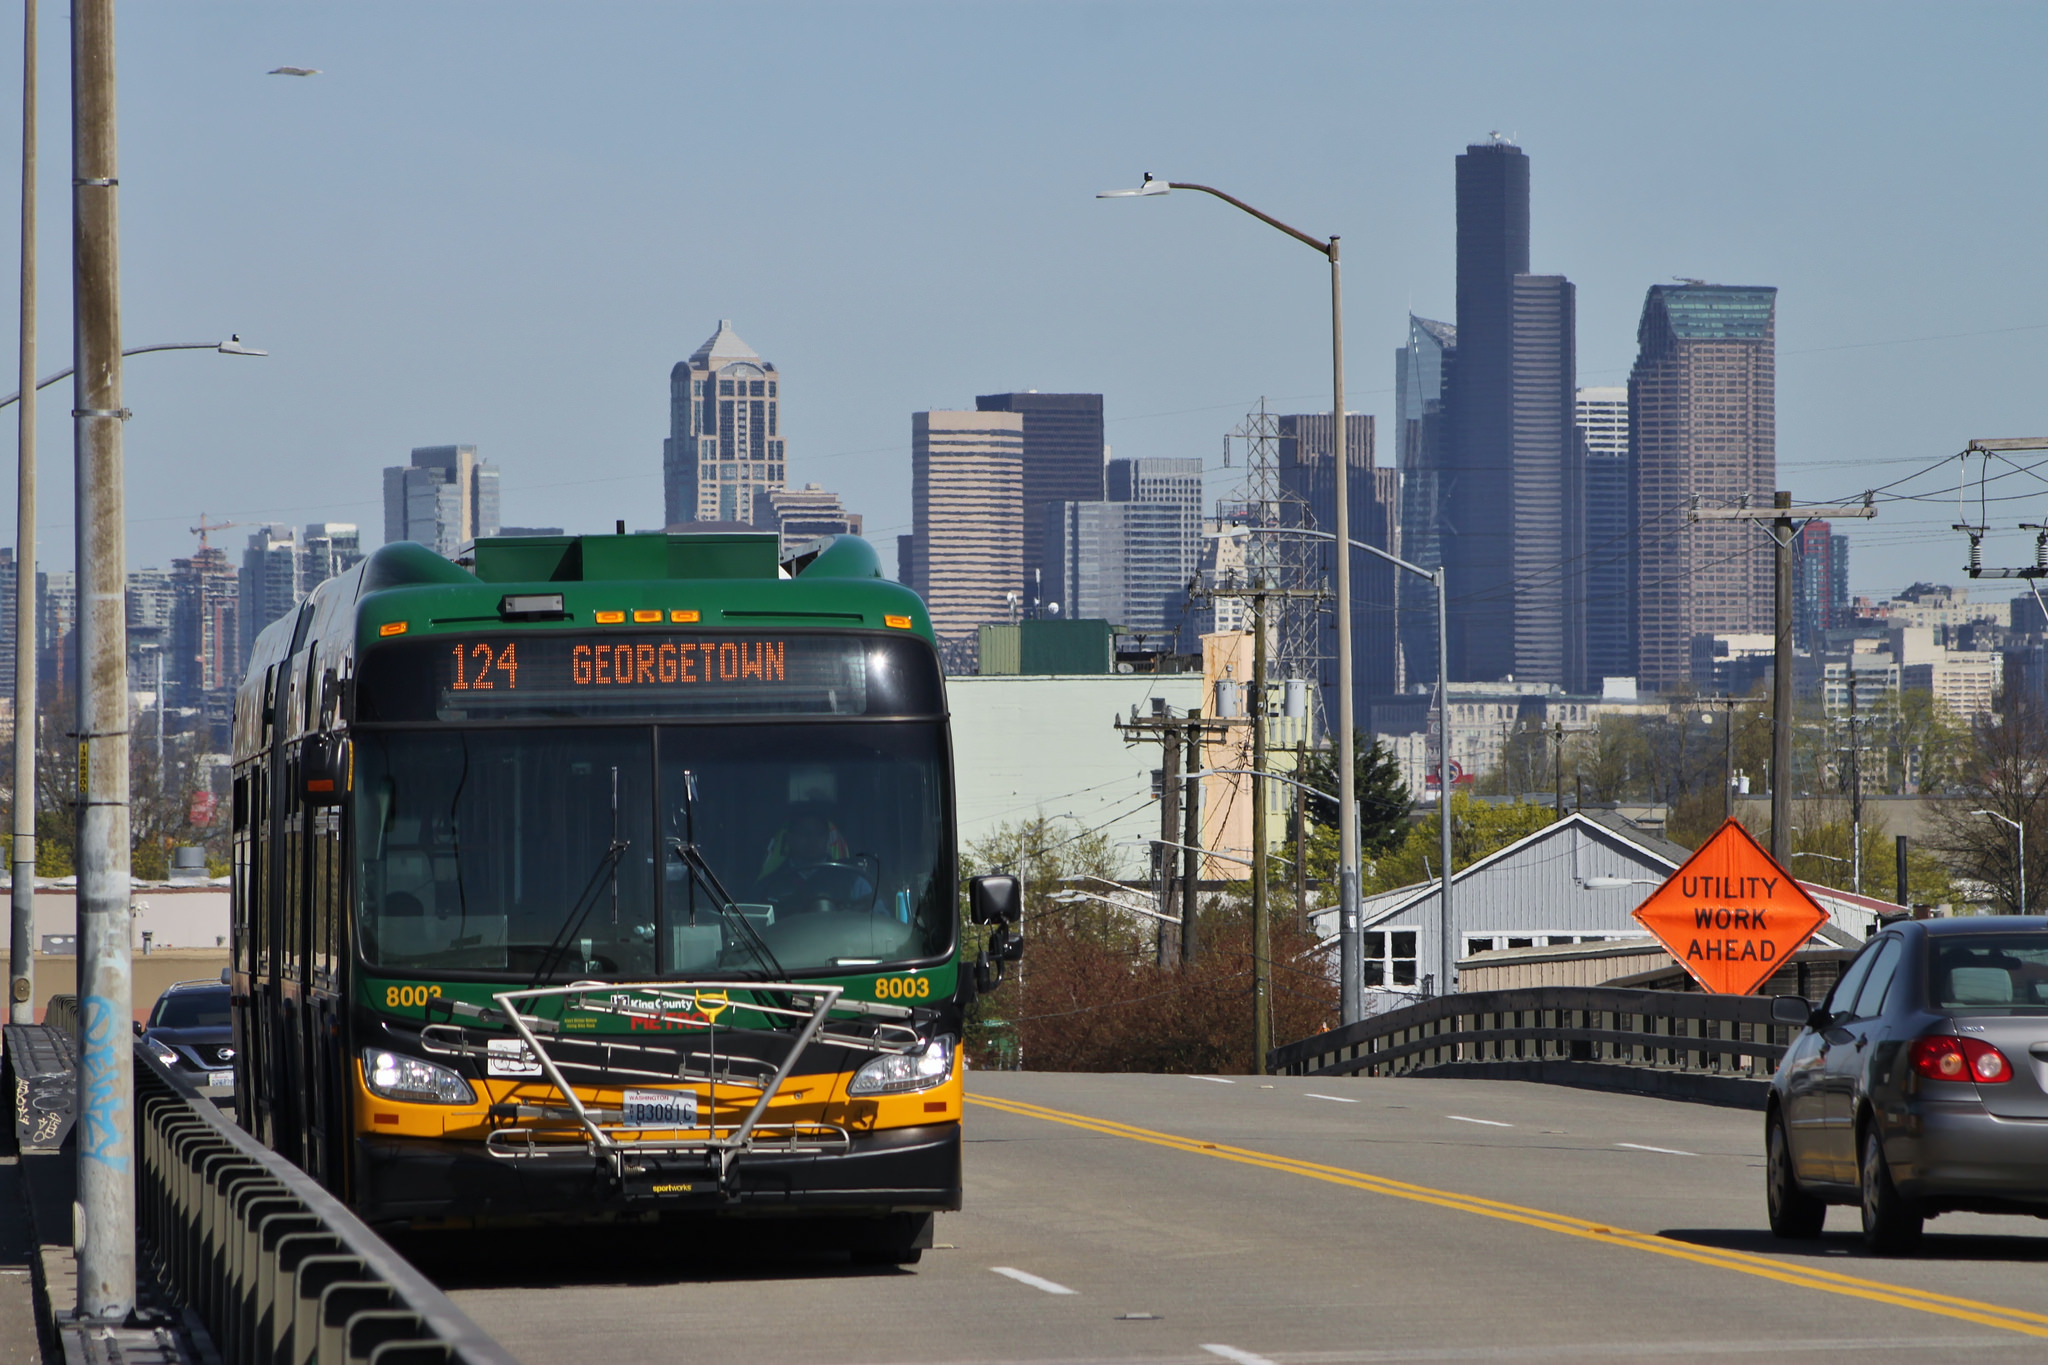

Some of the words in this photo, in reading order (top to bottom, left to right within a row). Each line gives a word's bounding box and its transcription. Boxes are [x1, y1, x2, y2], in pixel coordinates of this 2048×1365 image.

[451, 642, 518, 691] 124
[573, 642, 785, 684] GEORGETOWN
[1682, 876, 1778, 899] UTILITY
[1694, 908, 1767, 930] WORK
[1686, 939, 1776, 962] AHEAD
[875, 977, 931, 999] 8003
[631, 998, 655, 1010] King
[655, 998, 693, 1012] County
[631, 1011, 710, 1031] METRO
[636, 1103, 692, 1121] B3081C
[652, 1184, 692, 1193] sportworks
